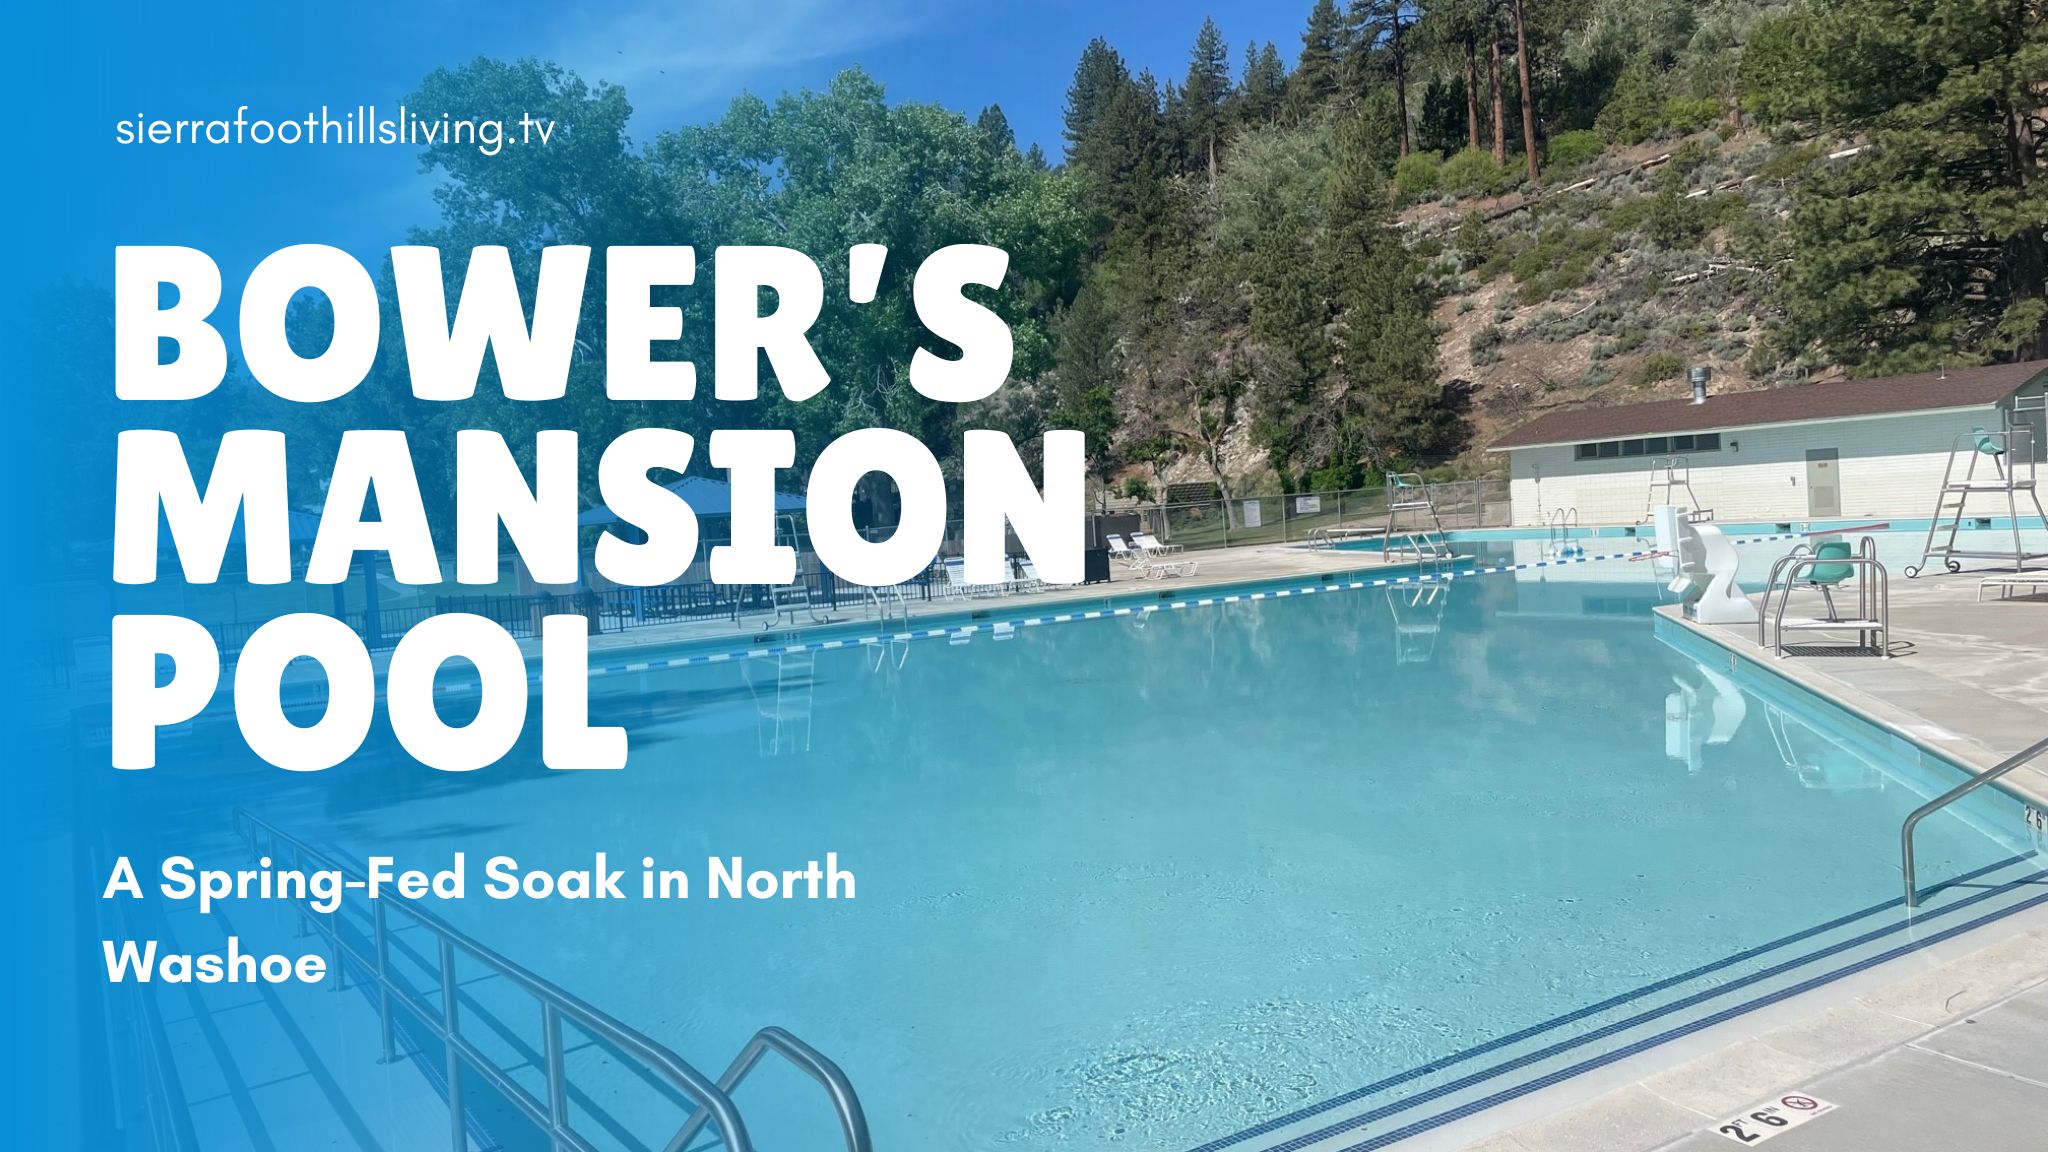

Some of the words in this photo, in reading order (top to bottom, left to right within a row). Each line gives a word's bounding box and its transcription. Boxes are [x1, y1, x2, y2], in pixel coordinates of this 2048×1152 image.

[2025, 804, 2032, 824] 2
[2036, 810, 2043, 831] 6
[1719, 1125, 1761, 1142] 2
[1750, 1111, 1789, 1127] 6
